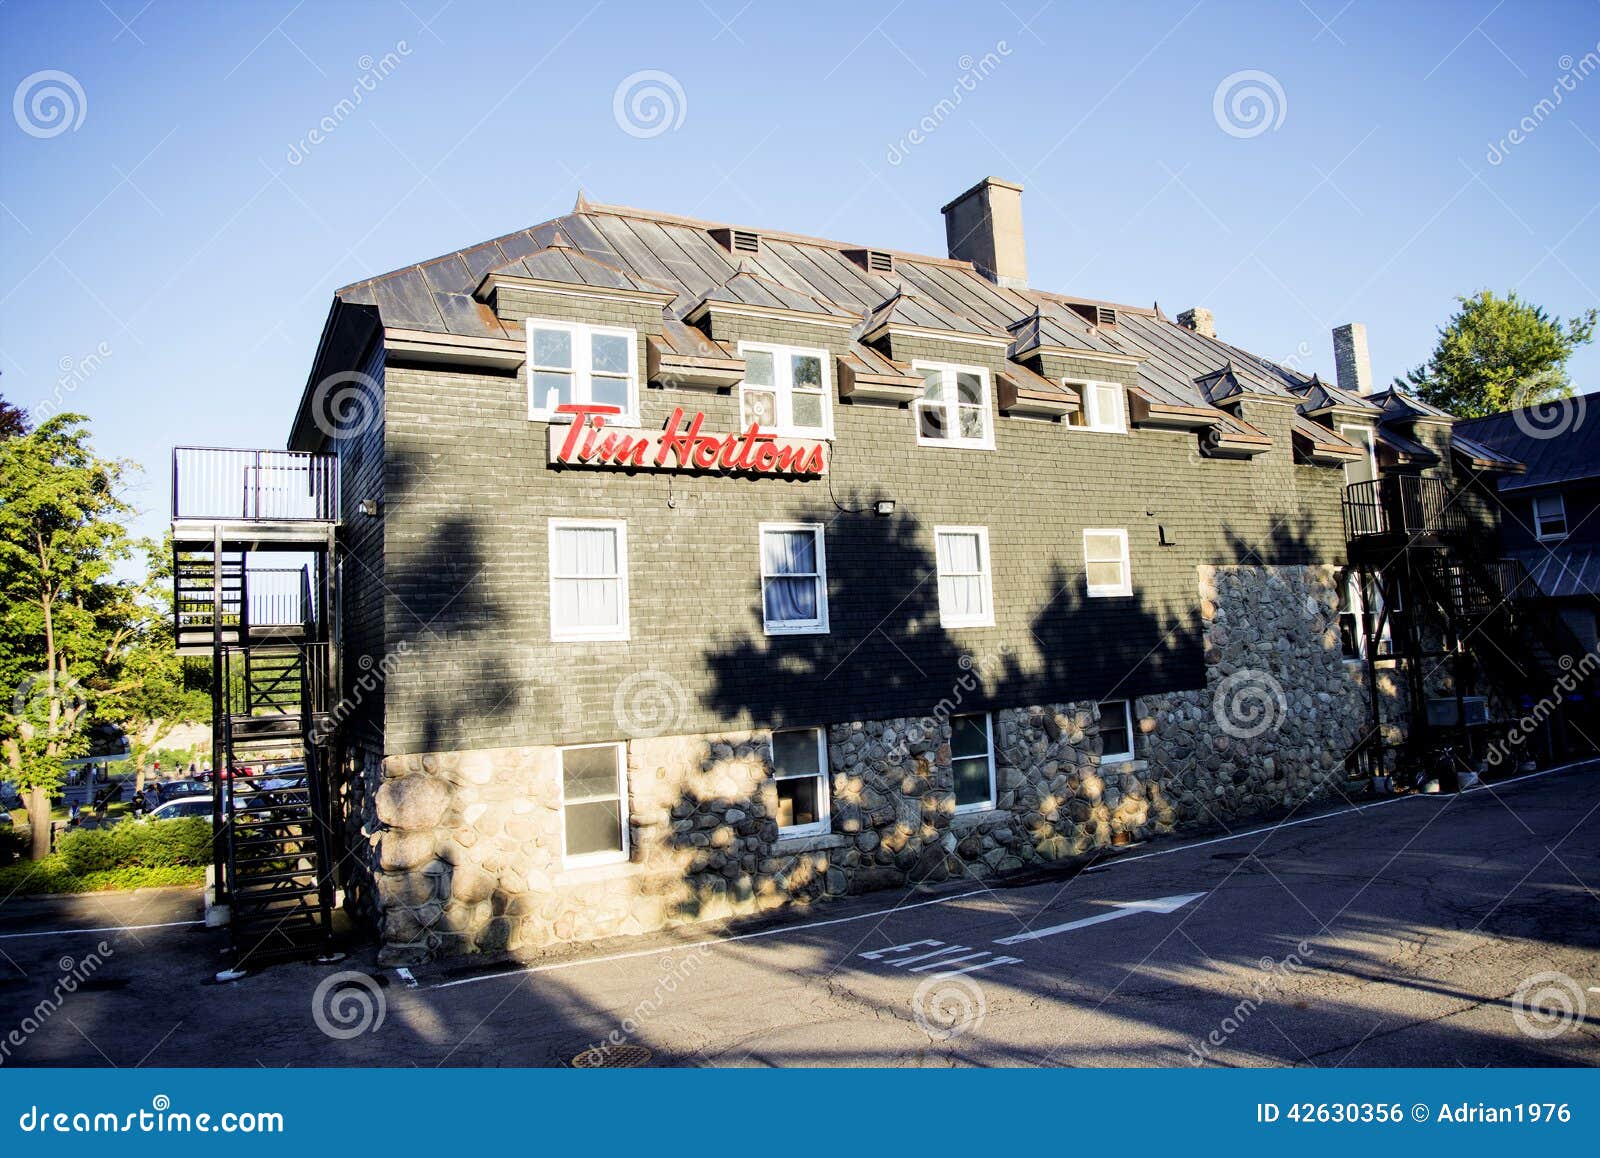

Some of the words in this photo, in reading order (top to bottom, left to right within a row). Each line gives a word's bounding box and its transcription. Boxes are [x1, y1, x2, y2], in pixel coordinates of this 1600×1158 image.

[556, 404, 649, 466] Tim
[653, 407, 824, 474] Hortons
[857, 938, 1025, 979] EXIT
